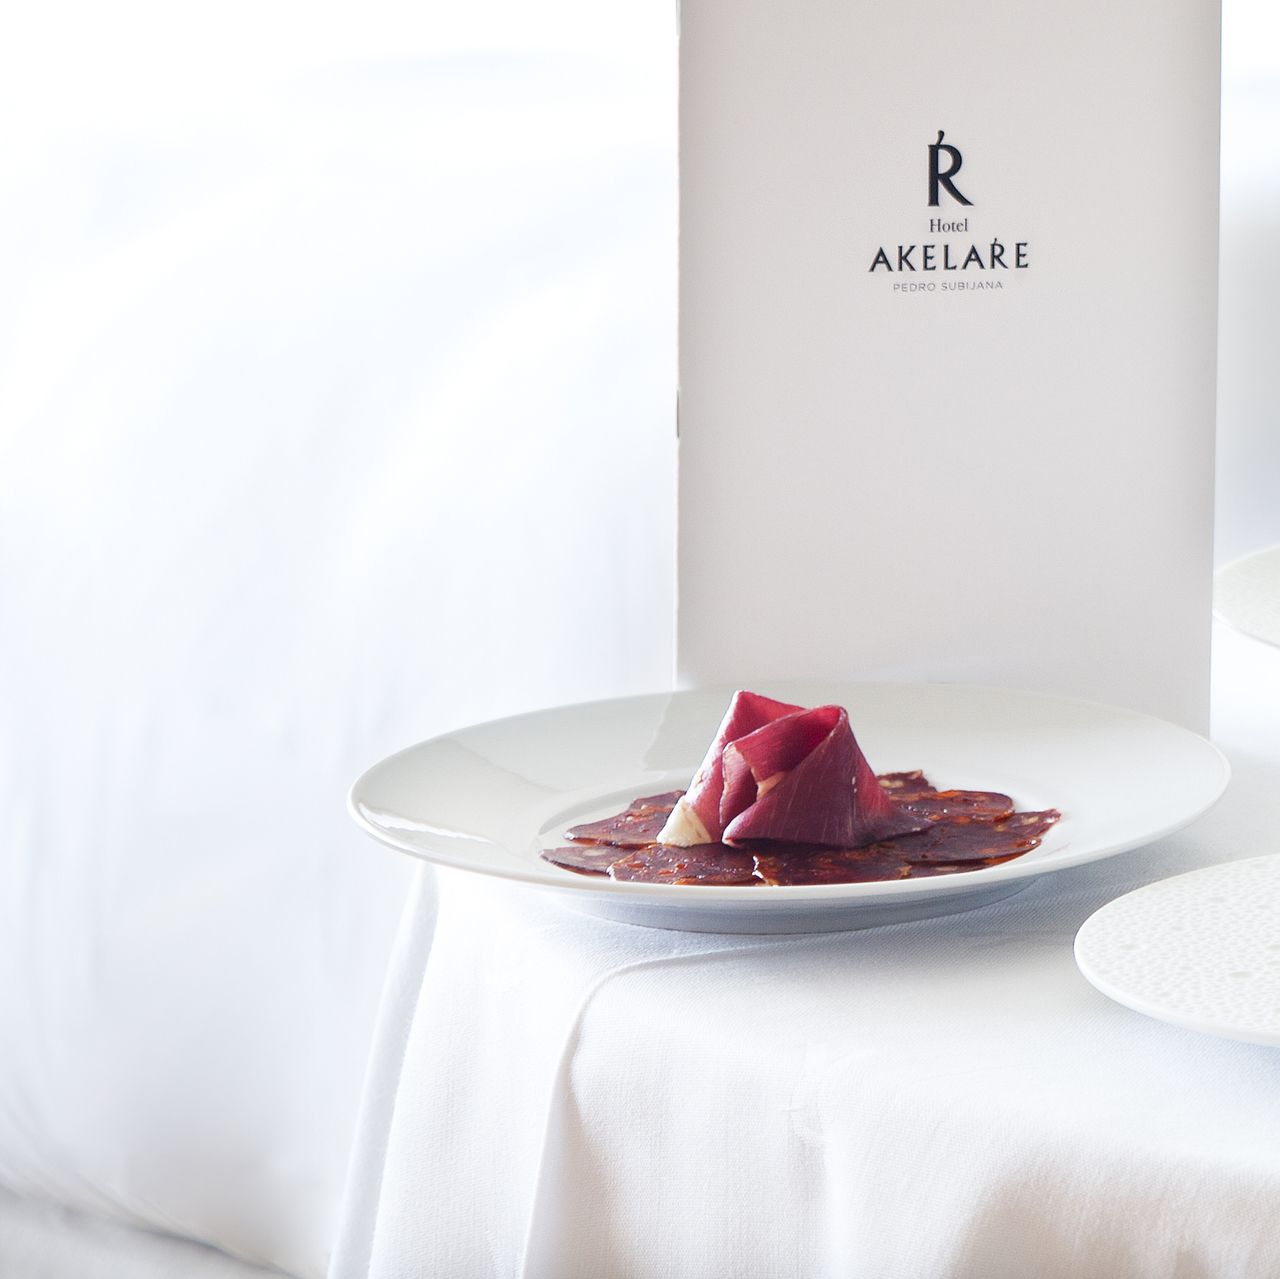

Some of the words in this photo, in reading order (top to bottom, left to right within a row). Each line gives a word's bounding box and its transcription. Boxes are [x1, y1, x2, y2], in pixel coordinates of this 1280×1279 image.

[929, 218, 969, 233] Hotel
[893, 282, 936, 293] PEDRO
[941, 280, 1003, 292] SUBIJANA
